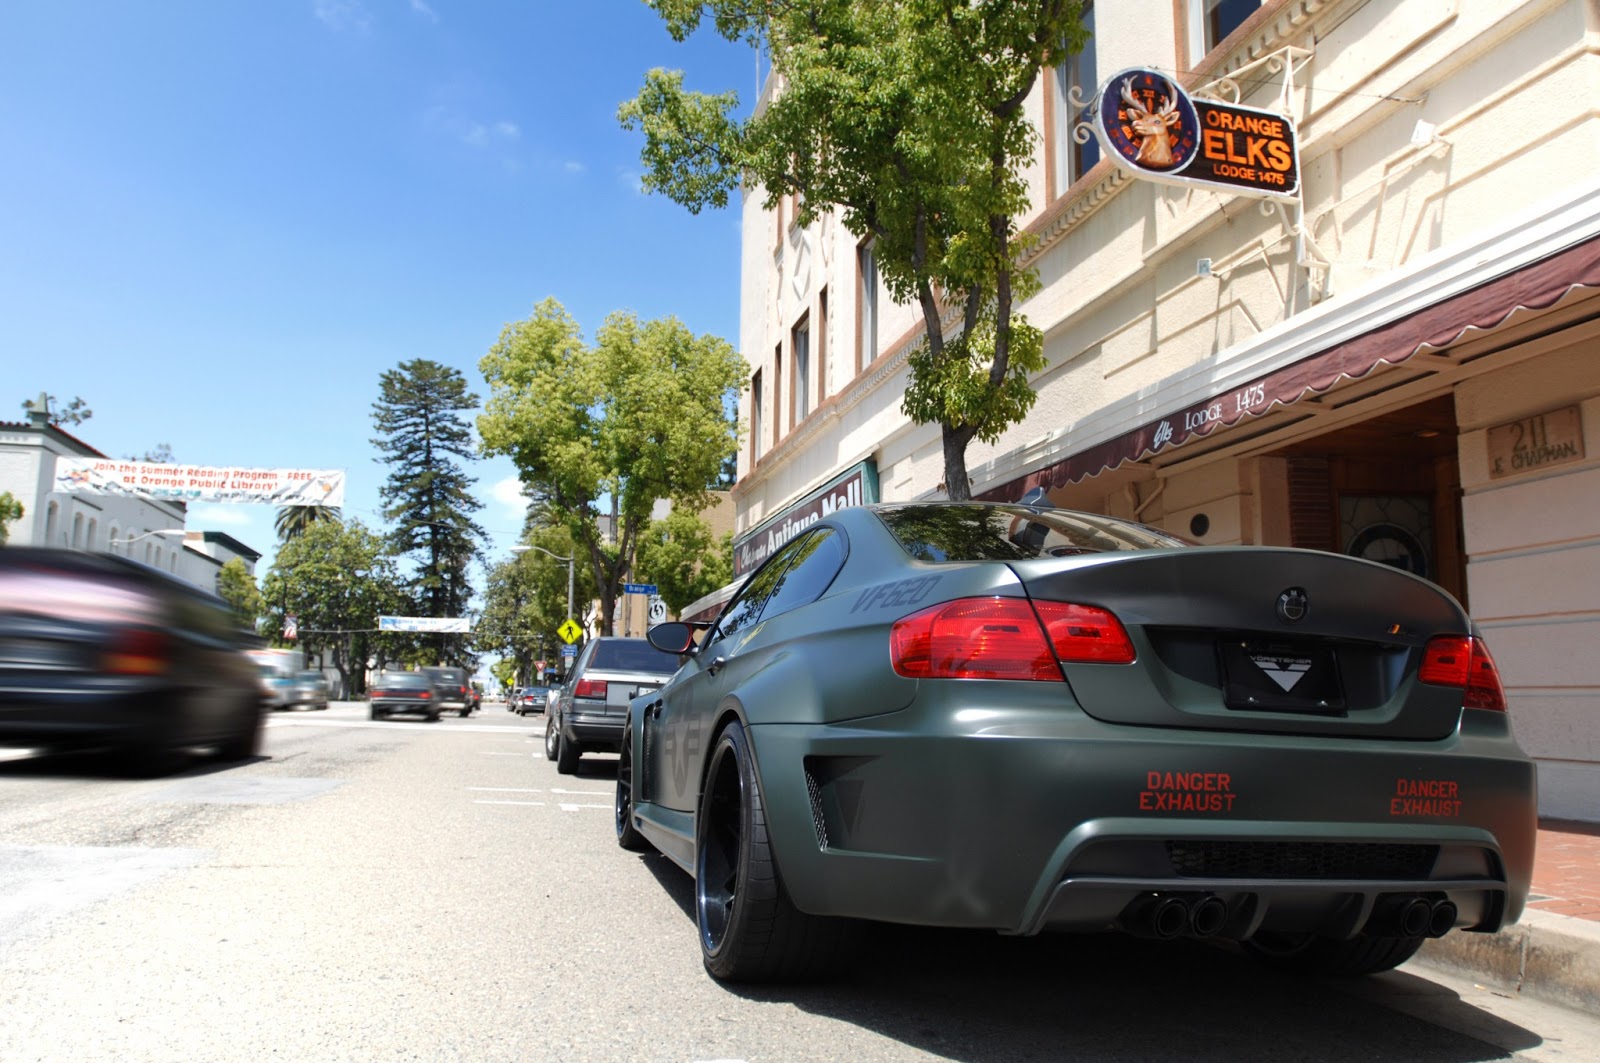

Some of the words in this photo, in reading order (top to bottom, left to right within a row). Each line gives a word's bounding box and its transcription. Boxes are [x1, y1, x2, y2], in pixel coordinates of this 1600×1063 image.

[1206, 111, 1283, 138] ORANGE
[1203, 128, 1292, 172] ELKS
[1213, 164, 1256, 181] LODGE
[1257, 171, 1285, 185] 1475
[1185, 403, 1222, 431] LODGE
[1235, 382, 1265, 413] 1475
[94, 463, 116, 471] Join
[119, 464, 137, 473] the
[140, 466, 184, 476] Summer
[187, 469, 230, 479] Reading
[233, 470, 278, 480] Program
[287, 472, 312, 480] FREE
[141, 476, 185, 487] Orange
[190, 479, 226, 489] Public
[231, 481, 278, 491] Library!
[822, 478, 861, 518] Mall
[1147, 771, 1231, 791] DANGER
[1396, 778, 1458, 798] DANGER
[1139, 791, 1236, 811] EXHAUST
[1390, 798, 1462, 816] EXHAUST
